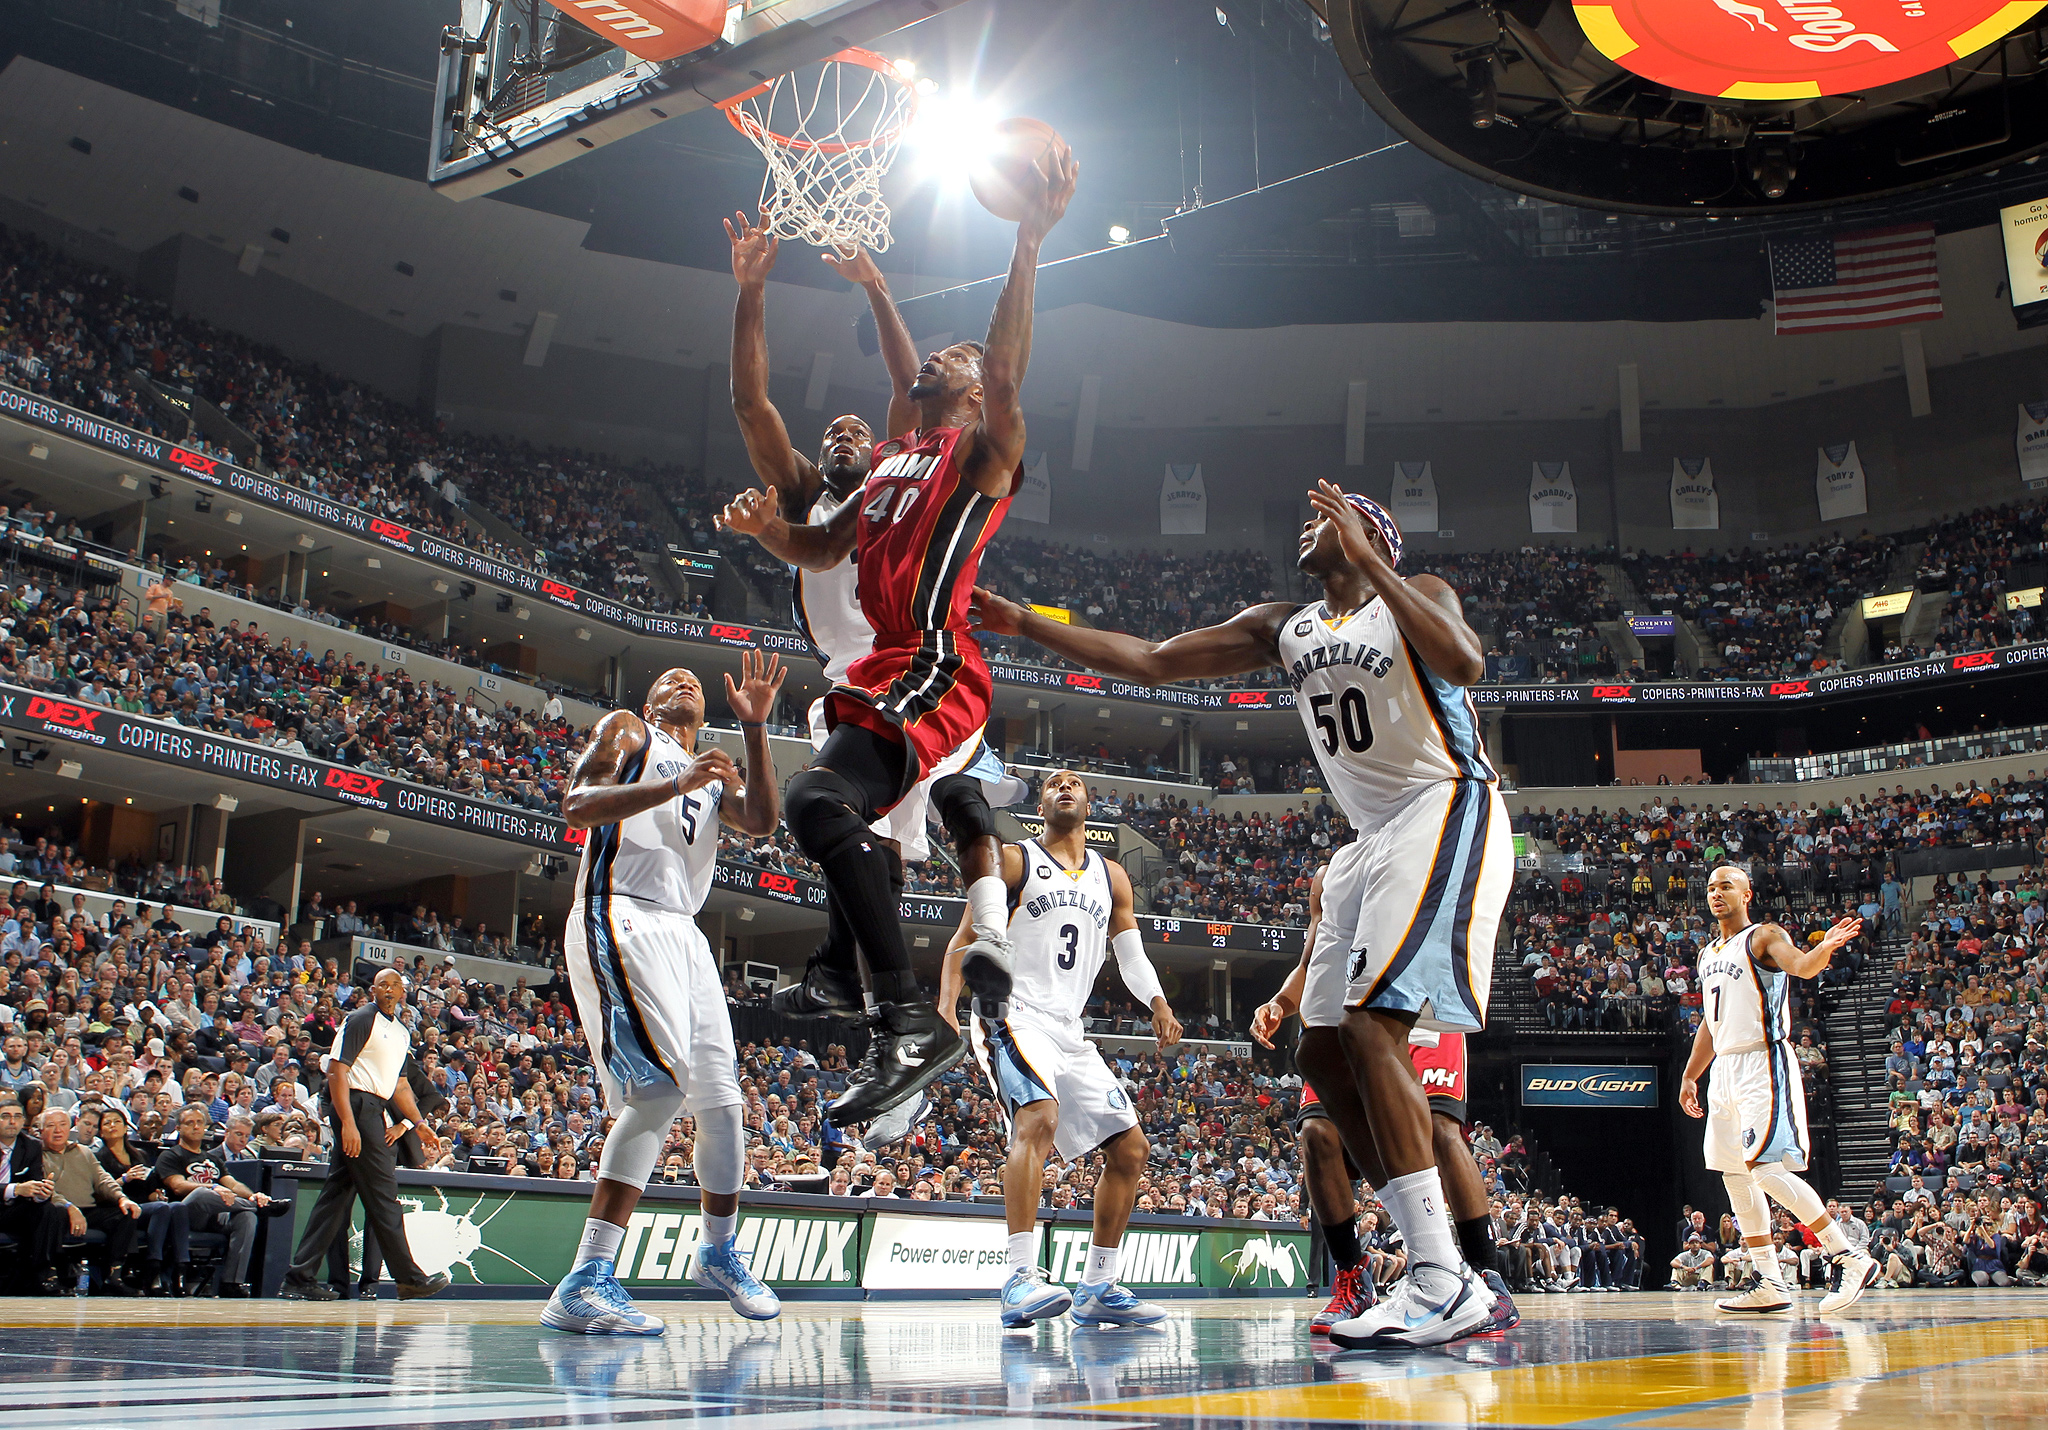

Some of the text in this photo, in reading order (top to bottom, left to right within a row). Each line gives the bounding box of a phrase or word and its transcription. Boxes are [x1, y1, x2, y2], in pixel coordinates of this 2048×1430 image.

[568, 0, 663, 39] rm
[2030, 205, 2042, 214] Go
[2014, 213, 2048, 227] hometo
[2025, 429, 2048, 443] MAR
[169, 447, 219, 475] DEX
[180, 465, 222, 485] imaging
[1825, 471, 1854, 483] TONY'S
[863, 486, 920, 524] 40
[370, 518, 412, 543] DEX
[380, 534, 415, 552] imaging
[541, 579, 578, 602] DEX
[550, 594, 580, 610] imaging
[709, 624, 753, 641] DEX
[720, 637, 757, 648] imaging
[763, 634, 808, 652] COPIERS
[391, 651, 401, 661] C3
[1953, 651, 1996, 670] DEX
[1290, 642, 1393, 693] GRIZZLIES
[1963, 662, 2000, 673] imaging
[486, 679, 496, 689] C2
[1065, 673, 1103, 689] DEX
[1770, 680, 1810, 695] DEX
[1074, 685, 1106, 696] imaging
[1228, 691, 1269, 704] DEX
[1592, 686, 1632, 698] DEX
[1779, 690, 1814, 700] imaging
[25, 696, 102, 731] DEX
[1309, 687, 1373, 758] 50
[42, 720, 107, 745] imaging
[704, 732, 715, 741] C2
[323, 767, 384, 798] DEX
[338, 789, 389, 810] imaging
[682, 795, 701, 845] 5
[1084, 829, 1115, 842] NOLTA
[1522, 859, 1537, 868] 102
[758, 871, 799, 893] DEX
[768, 889, 802, 904] imaging
[1026, 889, 1107, 930] GRIZZLIES
[1153, 919, 1181, 932] 9:08
[1207, 923, 1233, 936] HEAT
[1163, 933, 1170, 942] 2
[1212, 936, 1226, 948] 23
[369, 946, 387, 960] 104
[1057, 924, 1079, 970] 3
[1272, 940, 1280, 951] 5
[1700, 961, 1744, 980] IZZLIES
[1711, 985, 1720, 1022] 7
[1234, 1047, 1248, 1056] 103
[1527, 1078, 1652, 1092] BUD LIGHT
[890, 1242, 1010, 1270] Power over pest
